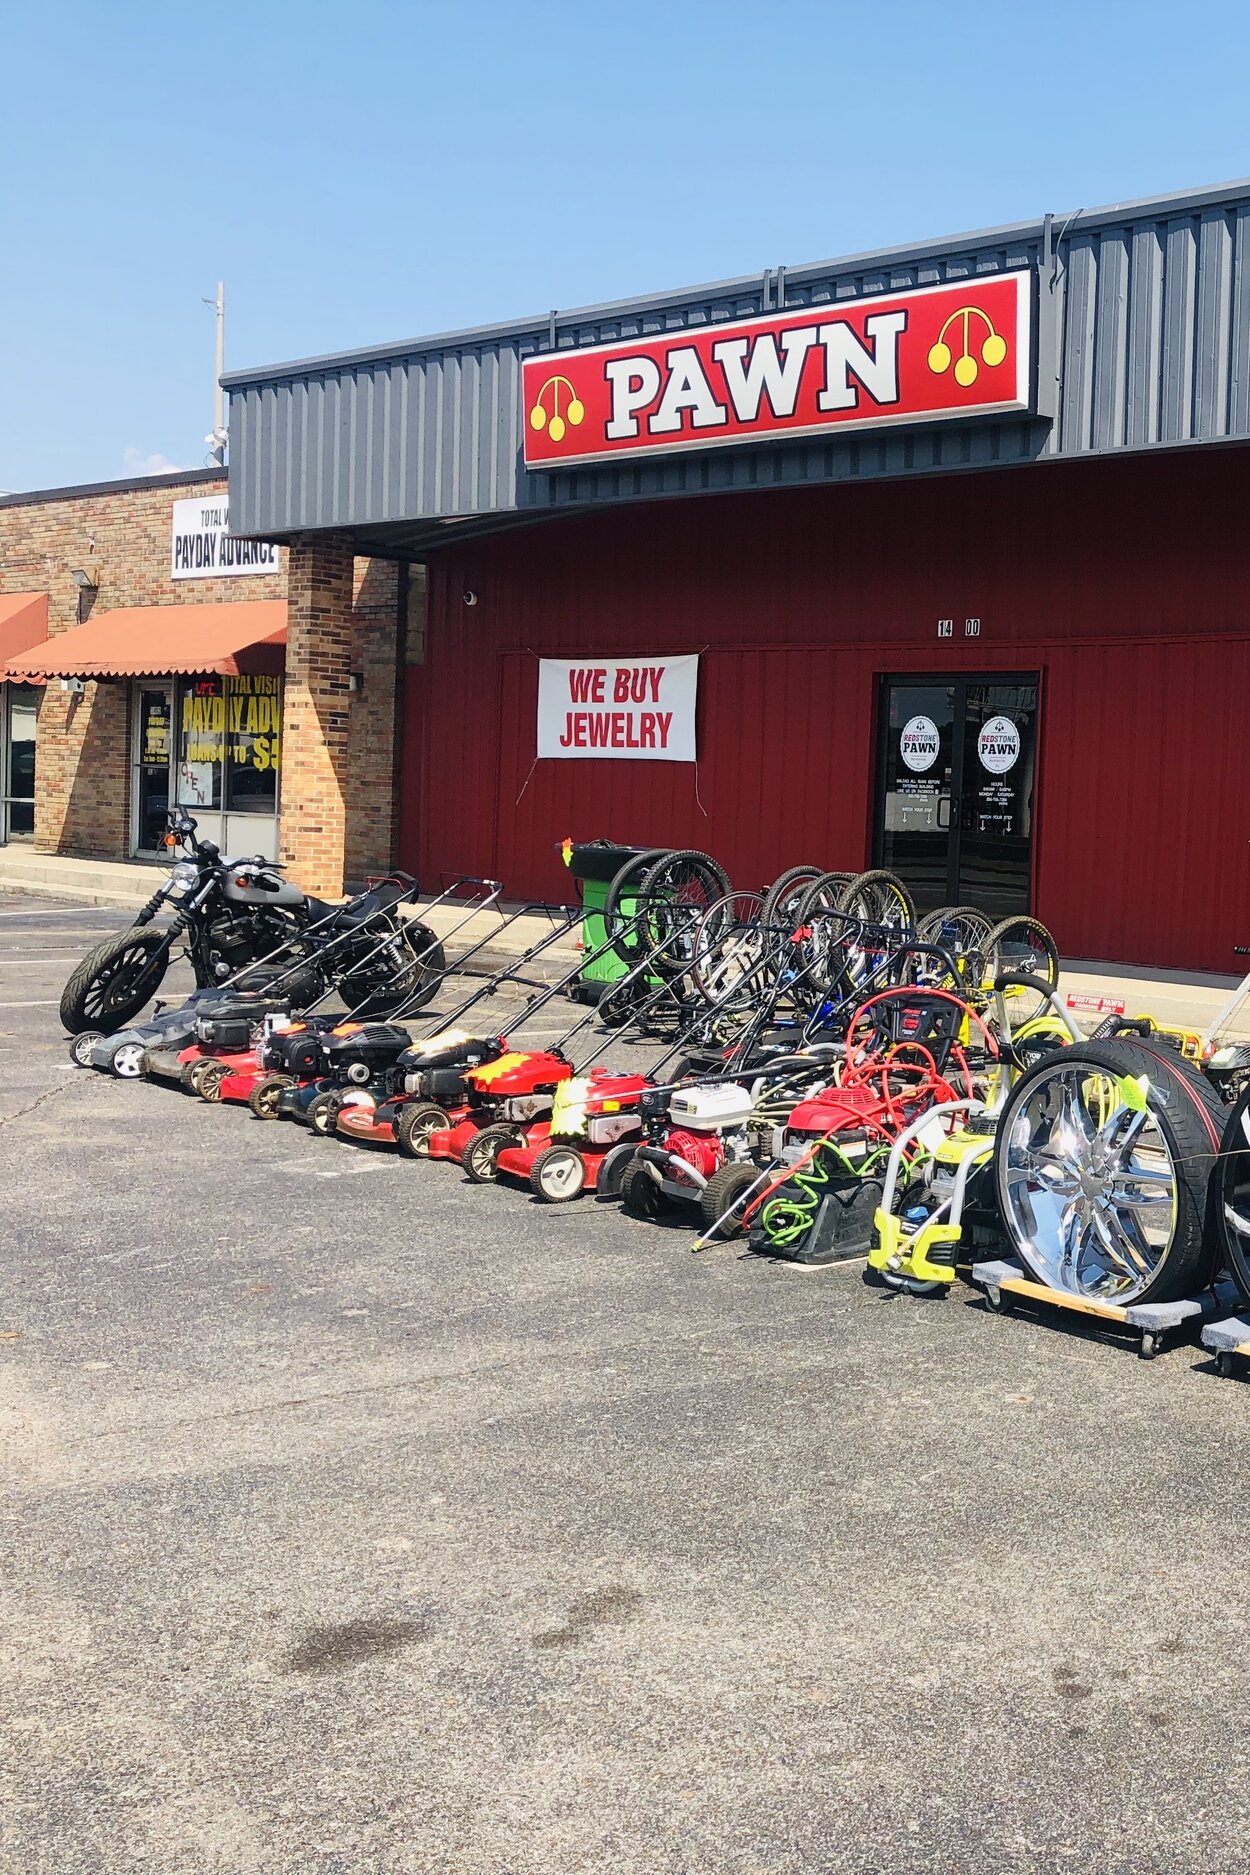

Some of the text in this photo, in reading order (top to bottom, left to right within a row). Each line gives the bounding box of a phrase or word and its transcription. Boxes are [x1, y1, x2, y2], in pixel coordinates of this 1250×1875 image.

[605, 310, 907, 440] PAWN
[201, 508, 222, 527] TOTAL
[175, 532, 275, 569] PAYDAY ADVANCE
[569, 667, 666, 703] WE BUY
[559, 712, 673, 748] JEWELRY
[903, 734, 937, 742] REDSTONE
[981, 735, 1017, 743] REDSTONE
[233, 745, 247, 764] TO
[903, 742, 937, 754] PAWN
[981, 743, 1017, 755] PAWN
[181, 763, 205, 805] OPEN
[1069, 995, 1125, 1007] REDSTONE PAWN
